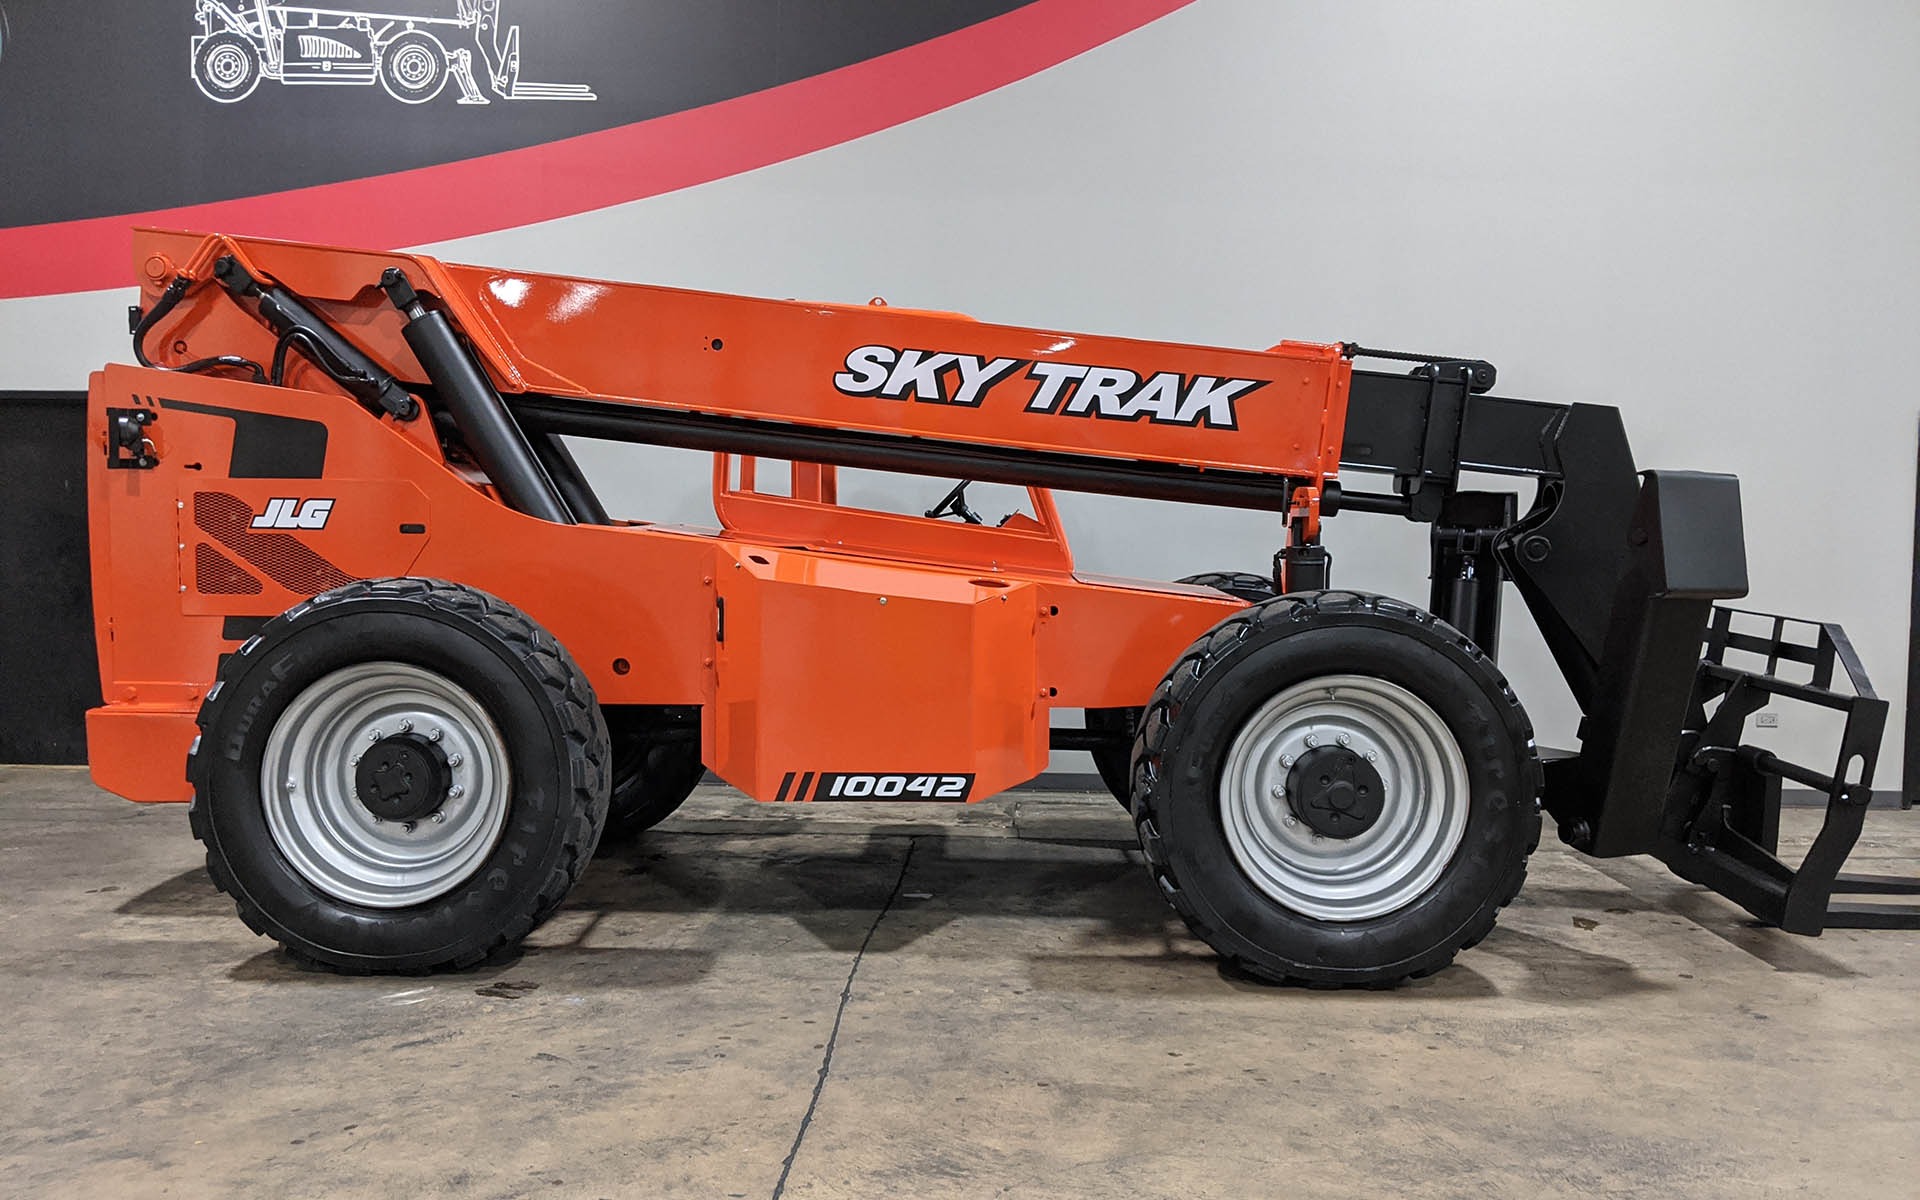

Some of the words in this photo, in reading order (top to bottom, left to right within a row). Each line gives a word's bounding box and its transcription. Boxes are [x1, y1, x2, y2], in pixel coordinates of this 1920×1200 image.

[834, 345, 1024, 405] SKY
[1025, 361, 1266, 429] TRAK
[250, 498, 335, 529] JLG
[829, 776, 967, 798] 10042
